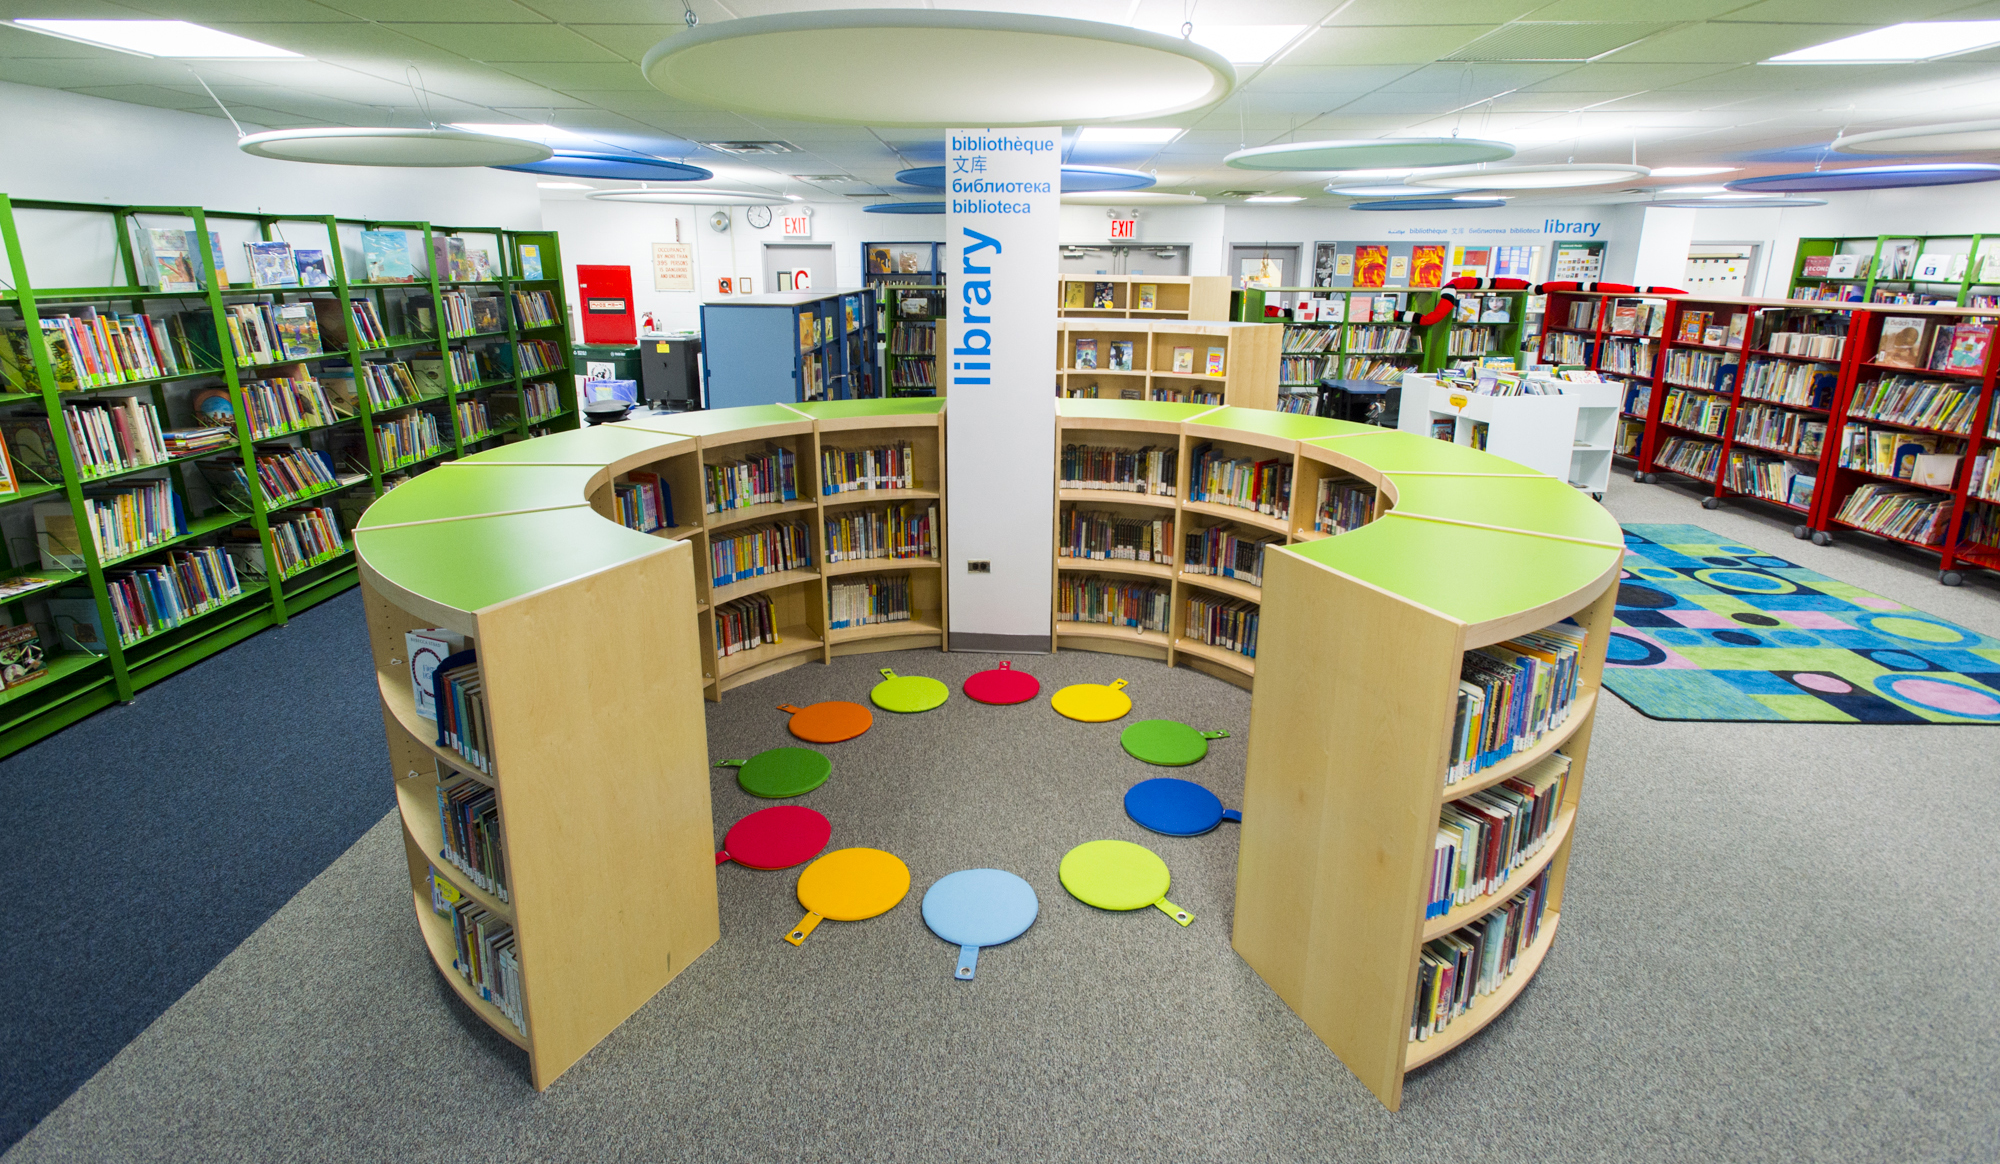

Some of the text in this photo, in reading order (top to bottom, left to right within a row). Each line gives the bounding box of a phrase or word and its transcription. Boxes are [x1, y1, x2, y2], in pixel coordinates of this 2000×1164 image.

[952, 136, 1054, 155] bibliothèque
[952, 155, 987, 174] 文库
[952, 178, 1051, 193] библиотека
[952, 199, 1031, 214] biblioteca
[784, 217, 807, 234] EXIT
[1111, 220, 1135, 238] EXIT
[1544, 219, 1601, 238] library
[953, 226, 1002, 385] library
